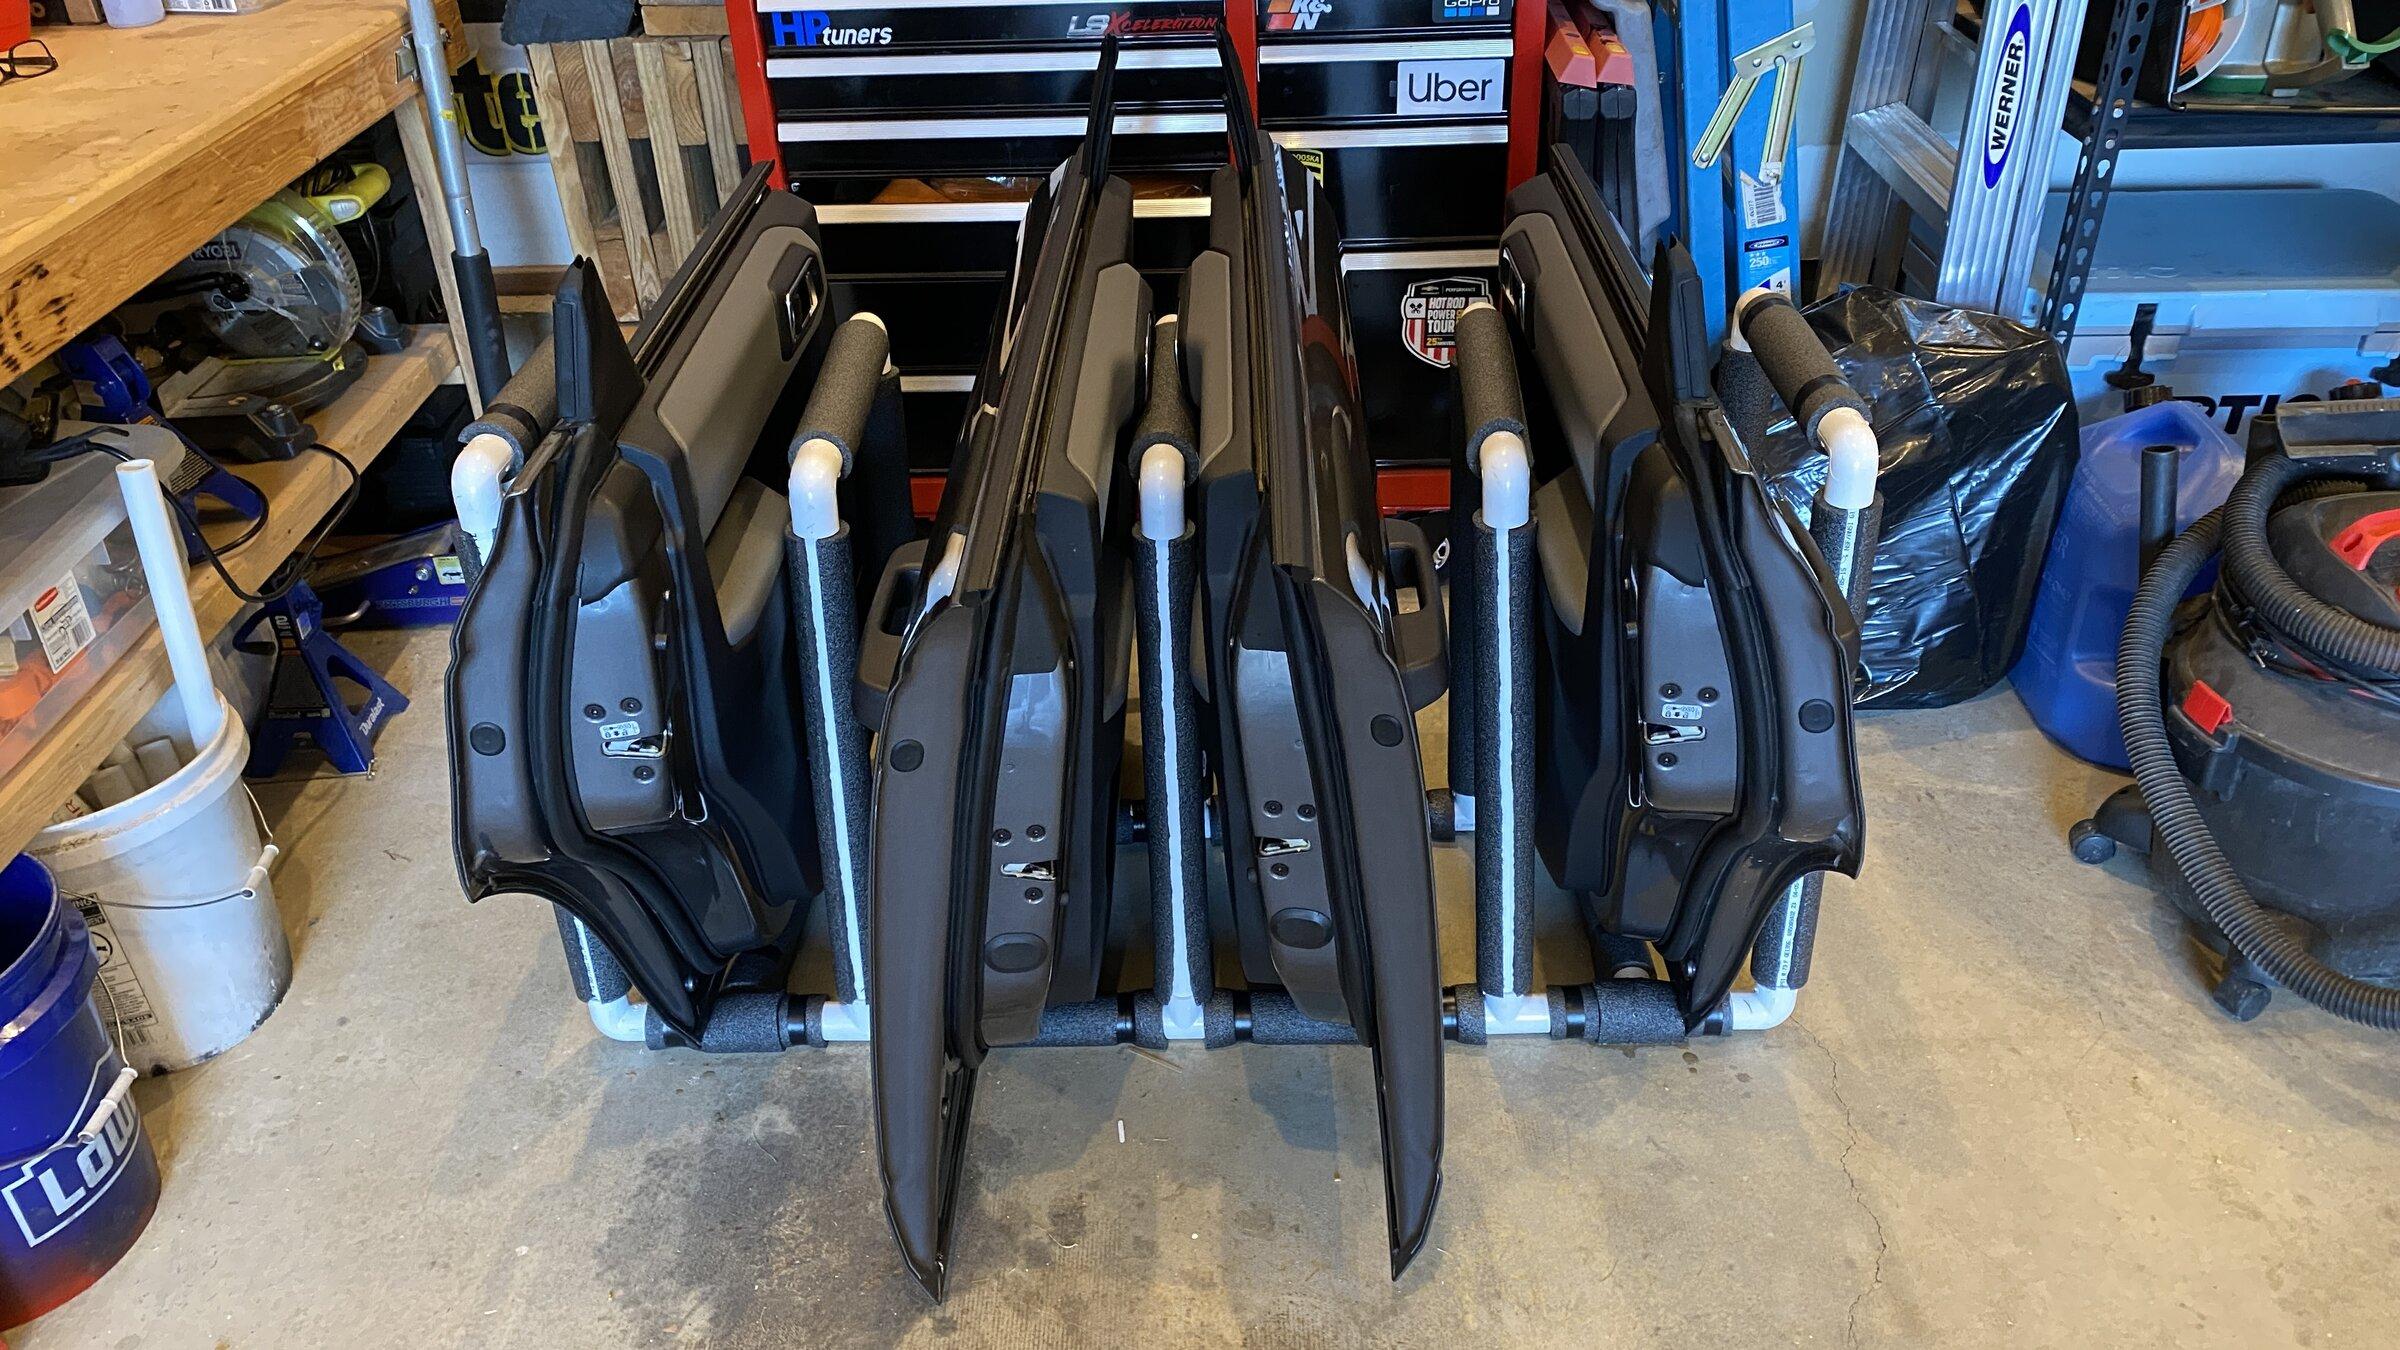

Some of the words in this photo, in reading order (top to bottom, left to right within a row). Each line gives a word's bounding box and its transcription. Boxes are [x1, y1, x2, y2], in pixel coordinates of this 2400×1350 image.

[771, 10, 830, 46] HP
[822, 26, 893, 45] tuners
[1408, 72, 1493, 102] Uber
[1990, 41, 2024, 150] WERNER
[194, 243, 238, 259] RYOBI
[1749, 256, 1769, 268] 250
[1427, 309, 1456, 320] POWER
[1427, 320, 1455, 333] TOUR
[38, 1087, 137, 1216] LOW
